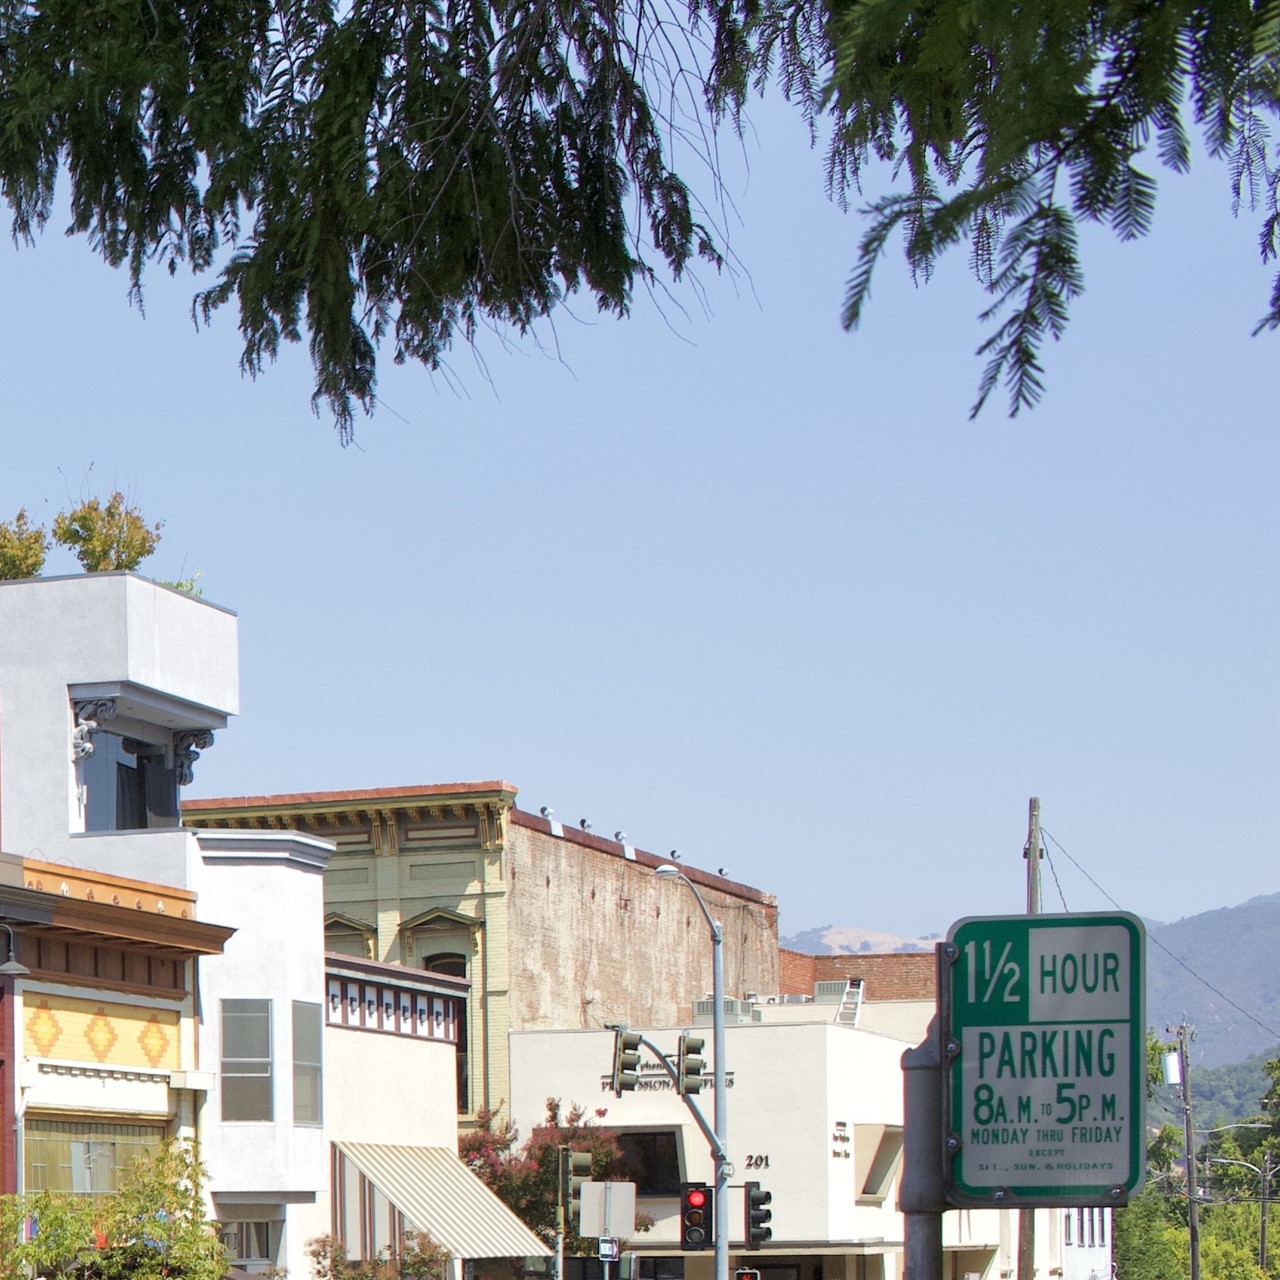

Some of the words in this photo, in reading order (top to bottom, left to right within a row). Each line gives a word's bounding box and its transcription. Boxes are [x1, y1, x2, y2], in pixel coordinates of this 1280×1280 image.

[1039, 952, 1120, 994] HOUR
[977, 1028, 1116, 1079] PARKING
[1040, 1102, 1052, 1117] TO
[970, 1127, 1029, 1145] MONDAY
[1036, 1128, 1064, 1142] THRU
[1071, 1126, 1123, 1144] FRIDAY
[1028, 1148, 1065, 1157] EXCEPT
[745, 1154, 770, 1168] 201
[1056, 1161, 1114, 1171] HOLIDAYS
